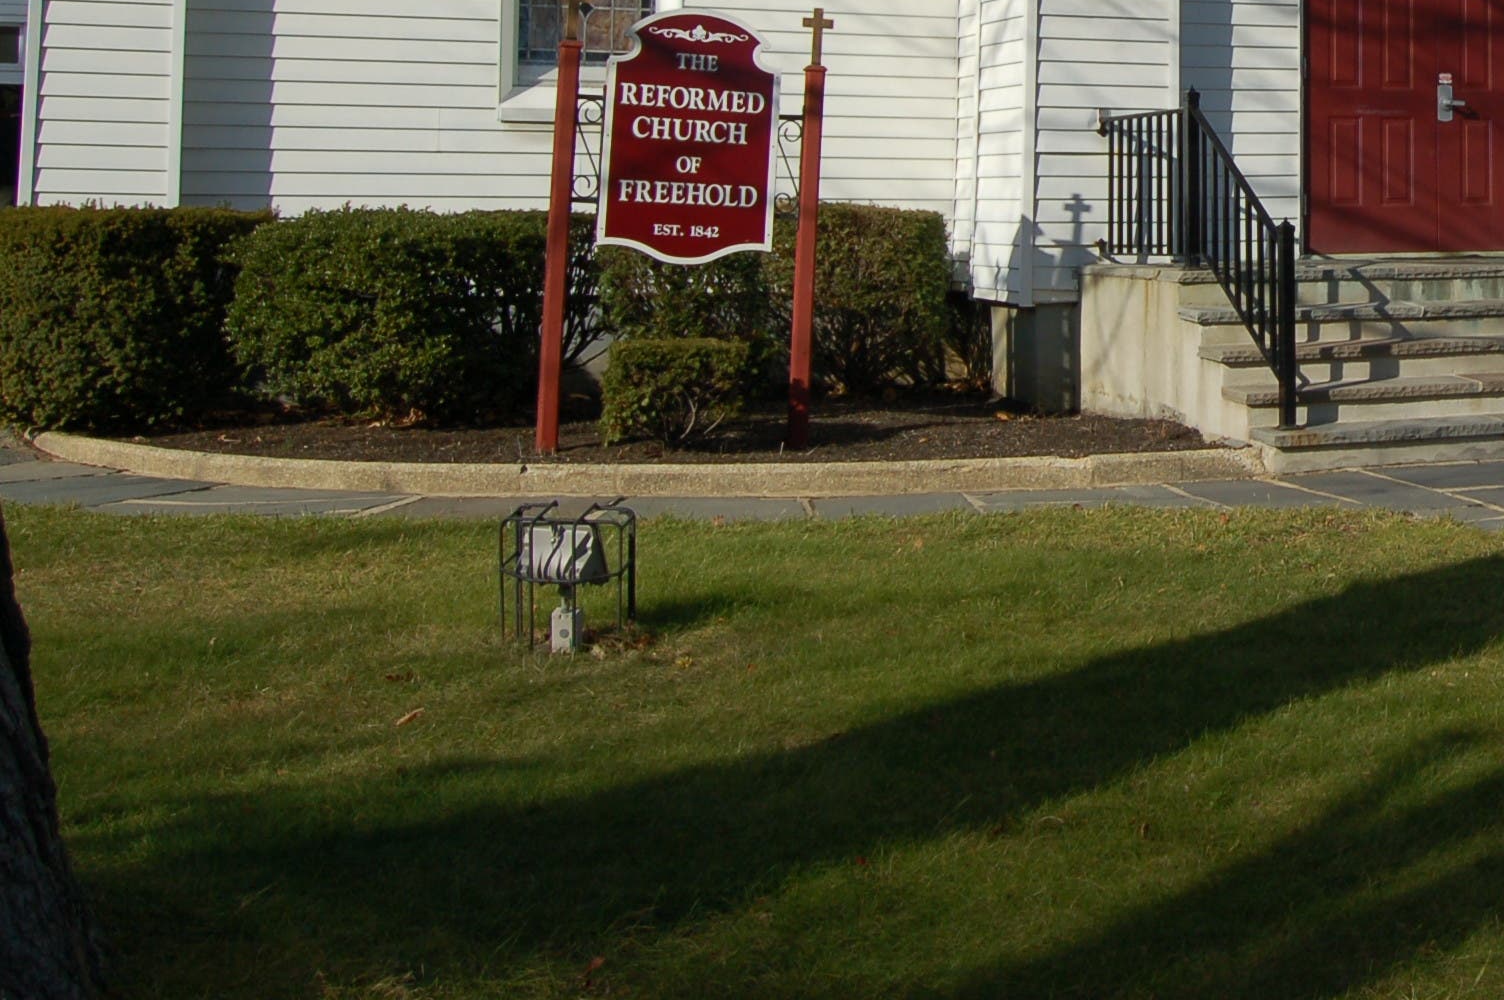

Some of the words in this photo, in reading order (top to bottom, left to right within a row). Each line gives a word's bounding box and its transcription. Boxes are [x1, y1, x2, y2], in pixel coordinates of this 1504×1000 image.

[676, 52, 719, 72] THE
[620, 82, 765, 114] REFORMED
[632, 116, 748, 145] CHURCH
[676, 156, 702, 174] OF
[618, 179, 758, 208] FREEHOLD
[653, 223, 684, 237] EST.
[690, 225, 719, 238] 1842
